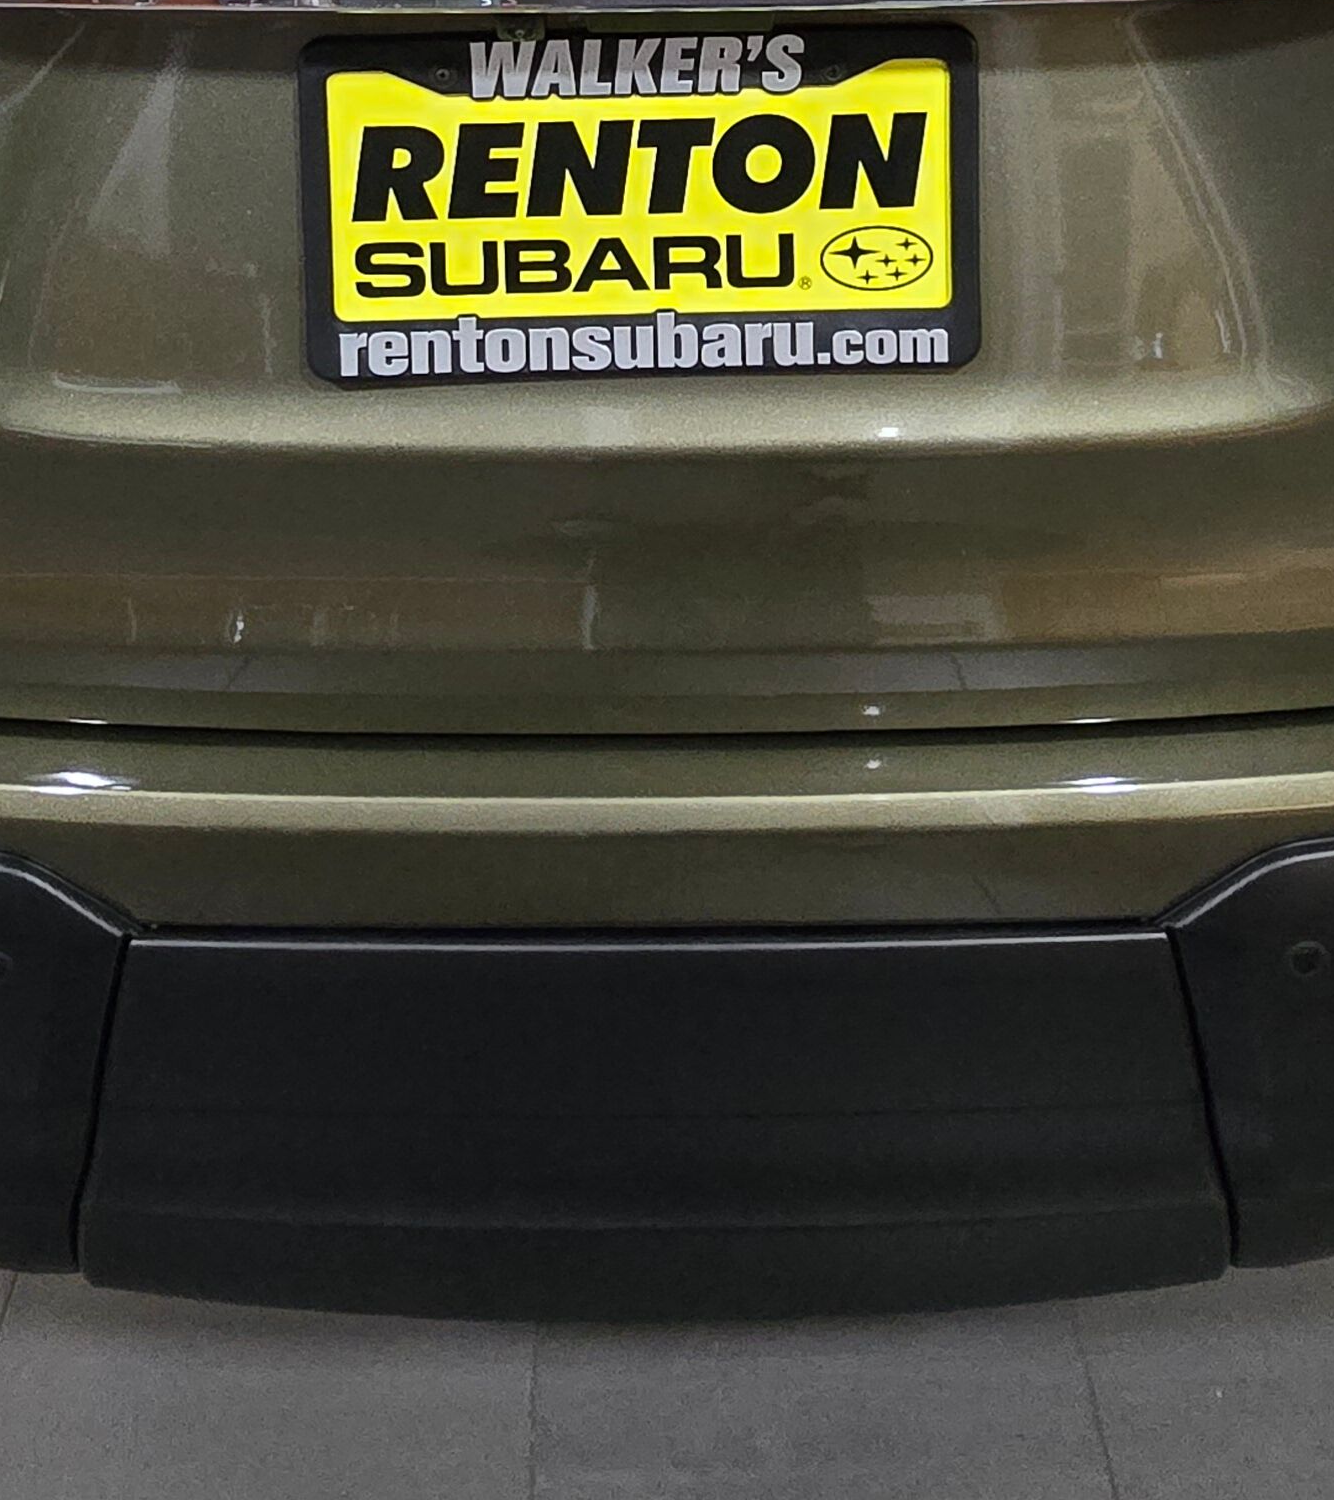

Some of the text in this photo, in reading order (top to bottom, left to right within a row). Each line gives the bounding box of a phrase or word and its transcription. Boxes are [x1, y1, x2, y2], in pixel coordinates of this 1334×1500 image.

[468, 34, 805, 100] WALKER'S
[352, 112, 927, 222] RENTON
[338, 311, 950, 378] rentonsubaru.com
